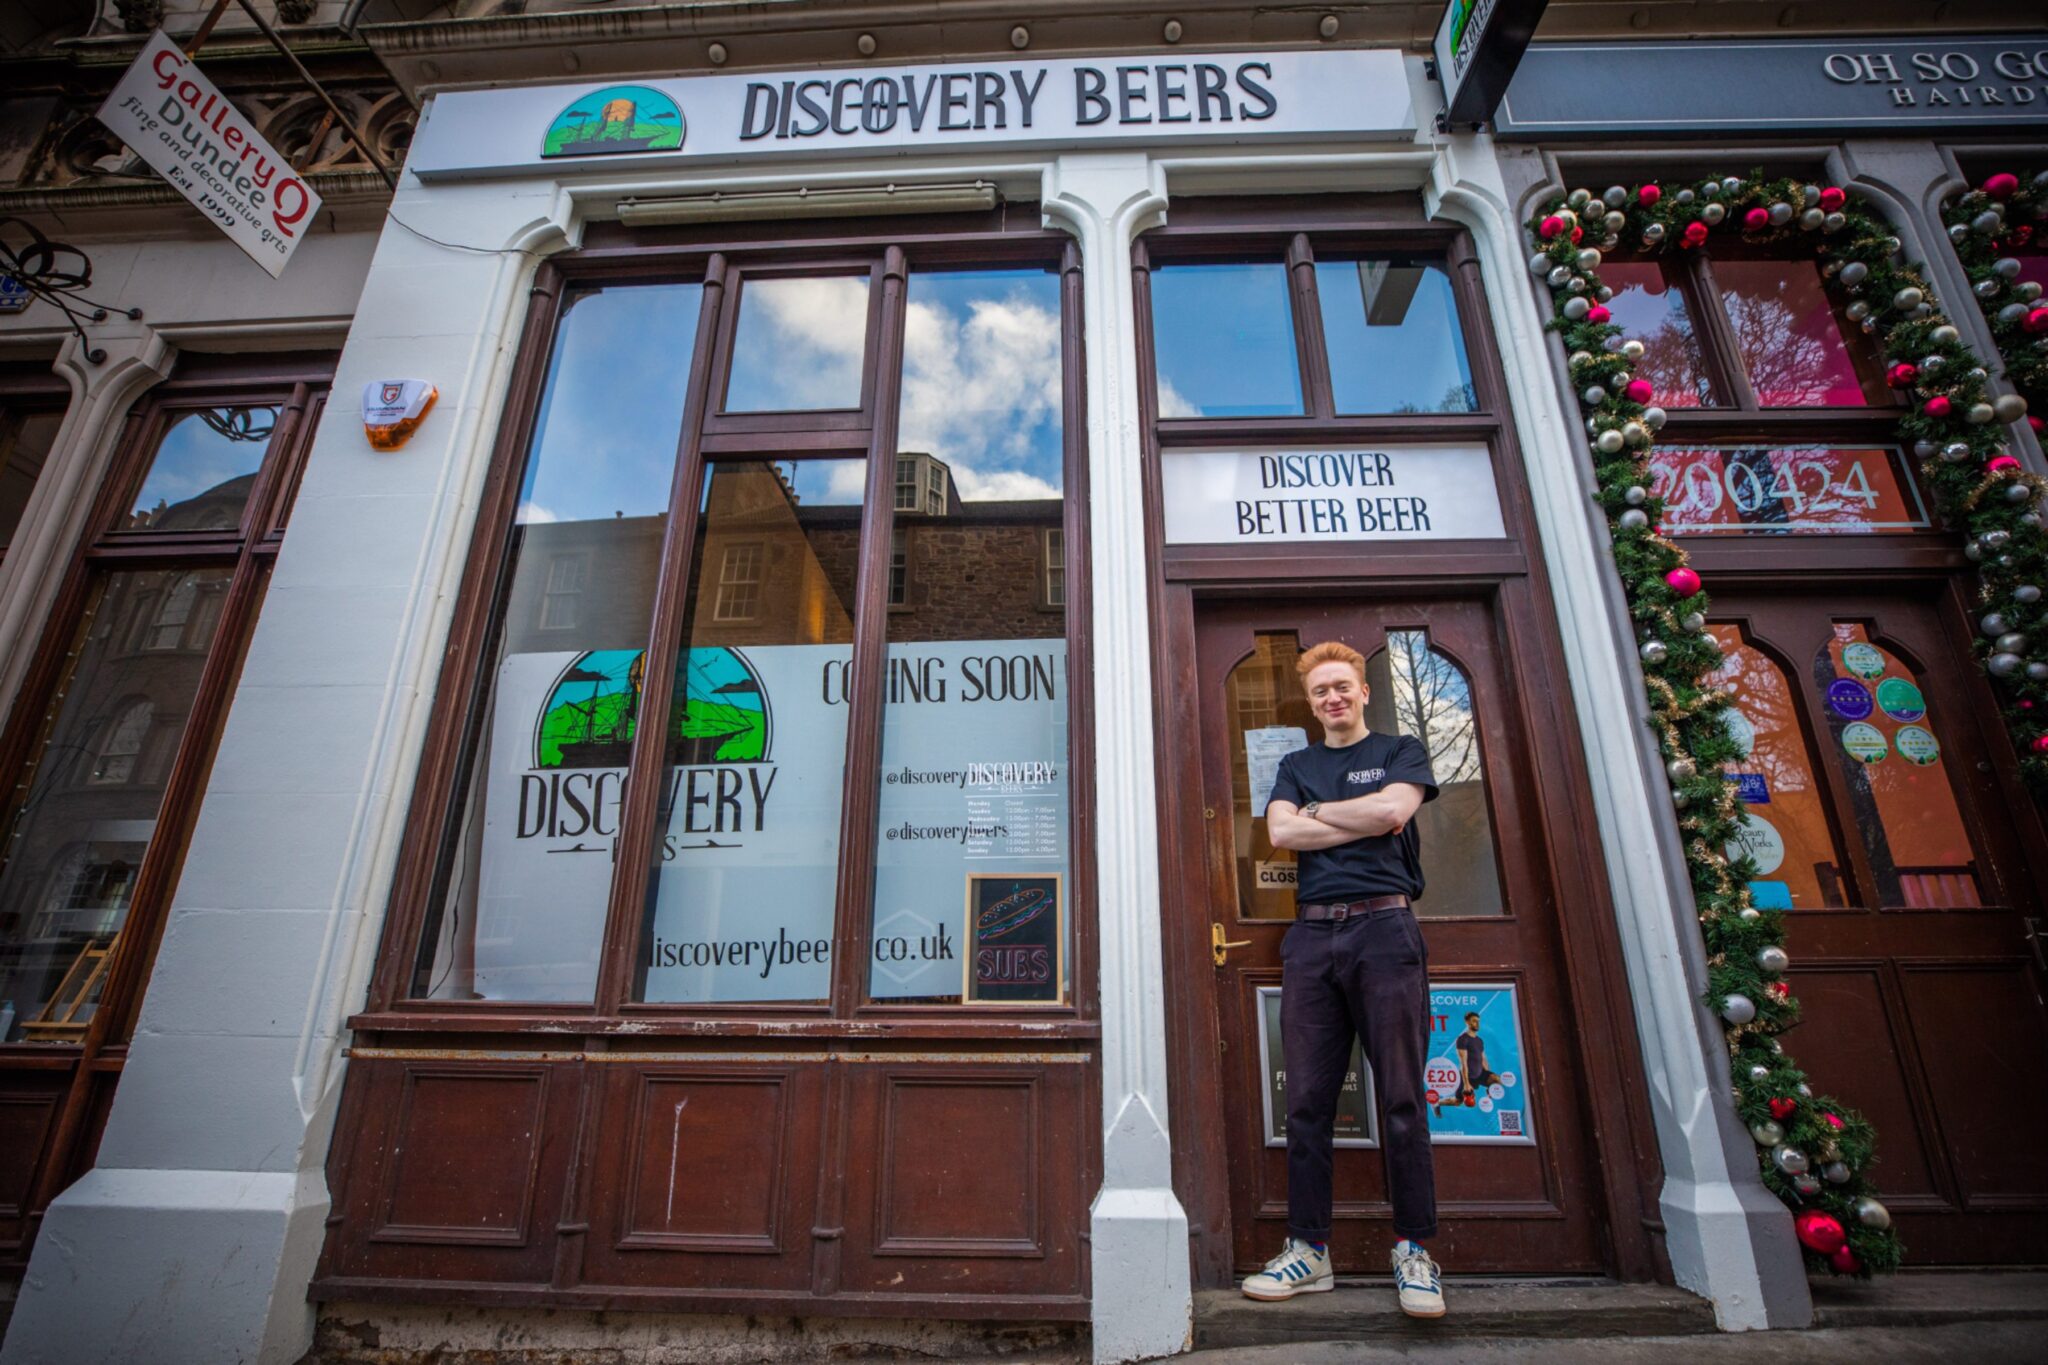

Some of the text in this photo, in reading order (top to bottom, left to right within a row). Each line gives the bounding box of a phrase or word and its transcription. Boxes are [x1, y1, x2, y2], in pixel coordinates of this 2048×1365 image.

[1823, 53, 1903, 83] OH
[1911, 51, 1980, 82] SO
[739, 62, 1277, 140] DISCOVERY BEERS
[1889, 85, 2048, 106] HAIRD
[119, 96, 159, 131] fine
[159, 131, 194, 162] and
[191, 161, 263, 229] decorative
[153, 50, 309, 238] Gallery Q
[158, 95, 266, 209] Dundee
[166, 165, 236, 228] Est 1999
[1260, 453, 1395, 489] DISCOVER
[1236, 498, 1431, 535] BETTER BEER
[822, 654, 1055, 706] CING SOON
[967, 761, 1055, 787] DISCOVERY
[976, 948, 1050, 981] SUBS
[1427, 1070, 1457, 1083] £20
